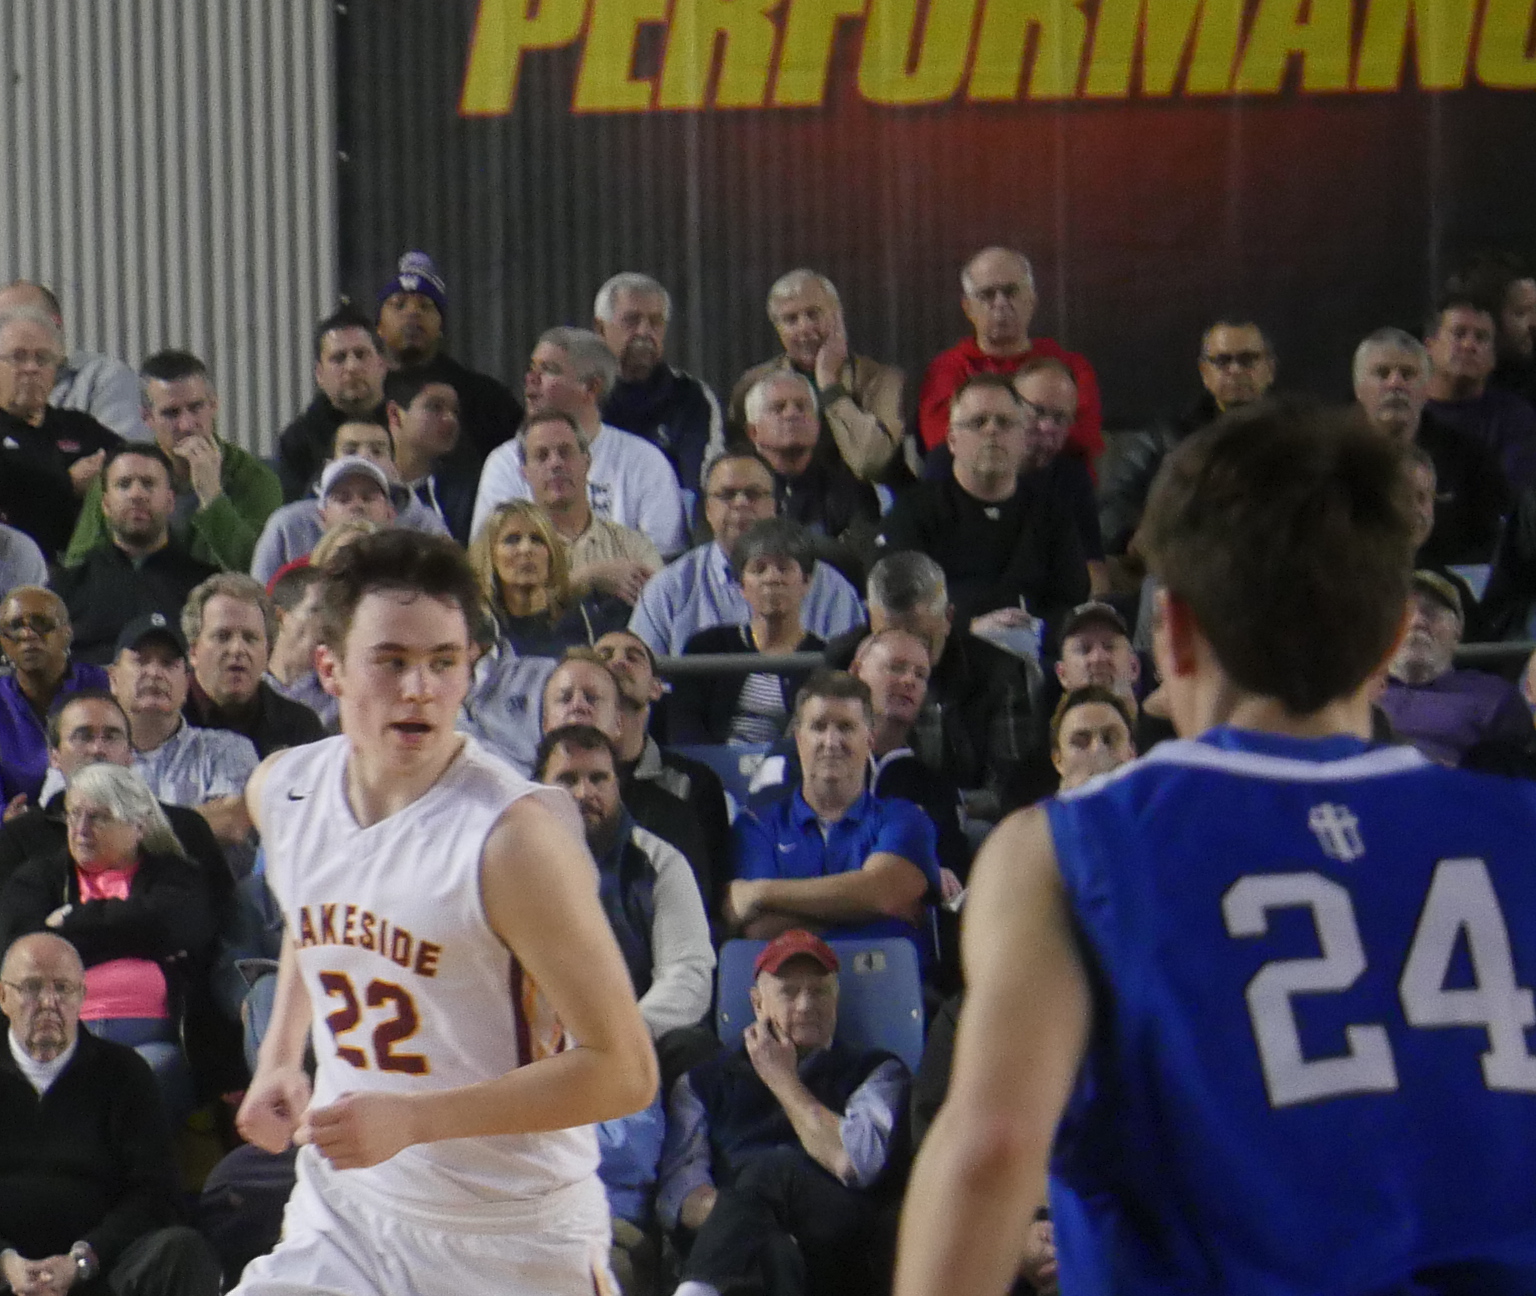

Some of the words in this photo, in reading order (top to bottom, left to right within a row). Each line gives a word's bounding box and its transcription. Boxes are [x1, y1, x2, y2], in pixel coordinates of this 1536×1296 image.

[293, 902, 443, 977] AKESIDE
[1221, 857, 1536, 1110] 24
[318, 969, 430, 1076] 22
